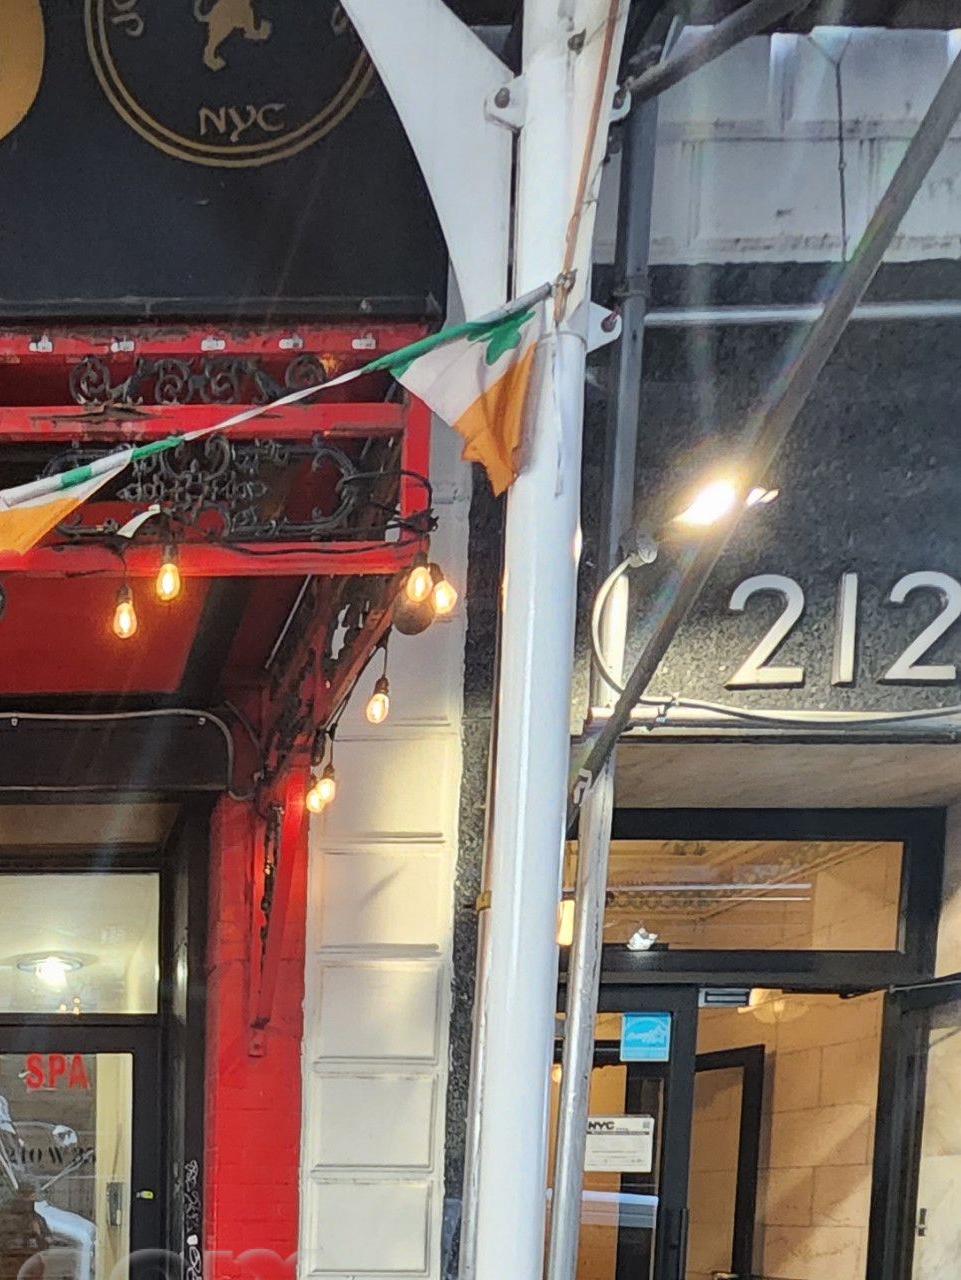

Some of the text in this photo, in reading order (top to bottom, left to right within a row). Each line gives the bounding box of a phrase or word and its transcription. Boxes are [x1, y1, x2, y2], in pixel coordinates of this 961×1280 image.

[198, 103, 286, 142] NYC
[725, 570, 961, 690] 212
[24, 1052, 92, 1090] SPA
[588, 1121, 615, 1130] NYC
